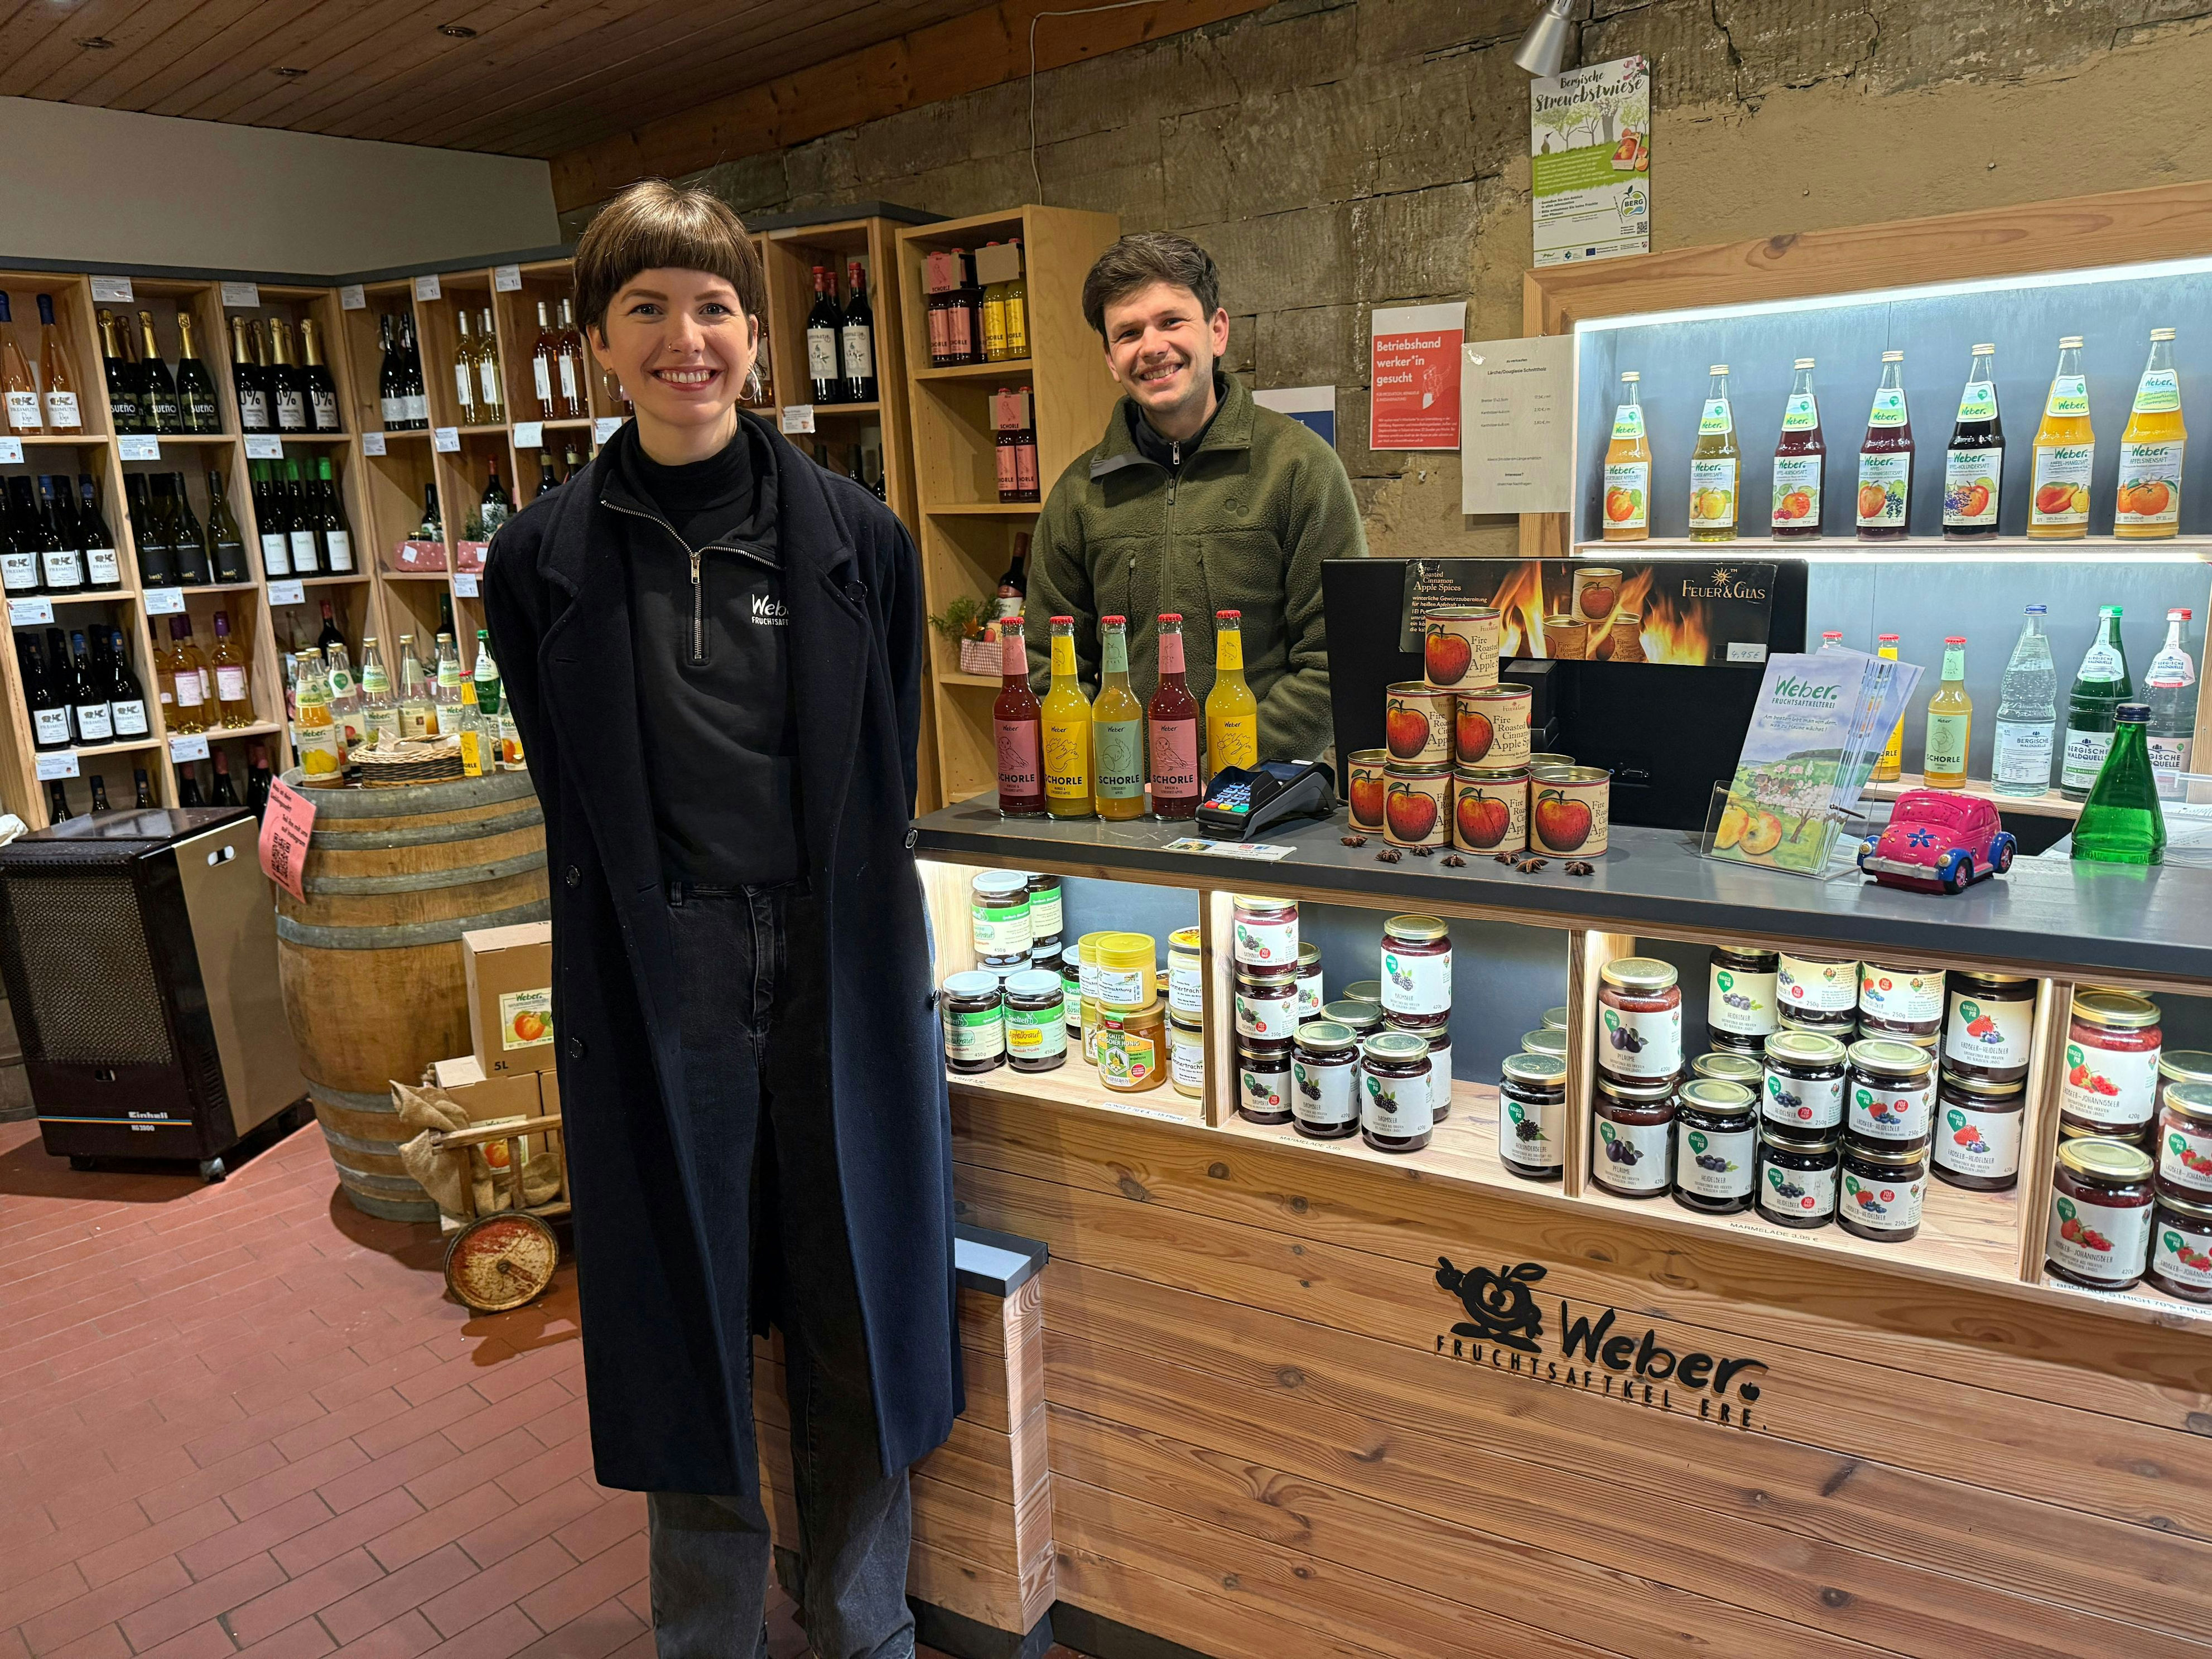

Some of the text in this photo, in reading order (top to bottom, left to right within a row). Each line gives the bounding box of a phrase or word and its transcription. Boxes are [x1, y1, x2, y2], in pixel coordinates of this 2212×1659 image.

[1560, 70, 1605, 89] Bergische
[1535, 79, 1645, 112] Streuobstwiese
[1625, 199, 1644, 207] BERG
[1377, 336, 1441, 351] Betriebshand
[1377, 372, 1413, 387] gesucht
[2055, 448, 2088, 459] Weber.
[2132, 445, 2168, 456] Weber.
[1864, 456, 1895, 466] Weber.
[1954, 452, 1987, 463] Weber.
[1695, 461, 1723, 472] Weber.
[1779, 459, 1807, 469] Weber.
[1609, 465, 1635, 475] Weber.
[1413, 581, 1461, 592] Apple Spices
[751, 594, 788, 616] Web
[1471, 636, 1487, 644] Fire
[1468, 659, 1495, 672] Apple
[1775, 675, 1842, 700] Weber.
[1772, 698, 1835, 708] FRUCHTSAFTKELTEREI
[1493, 716, 1511, 724] Fire
[1498, 721, 1526, 732] Roasted
[302, 729, 326, 737] Weber.
[1428, 734, 1453, 747] Apple
[1491, 738, 1521, 752] Apple
[1926, 754, 1960, 763] SCHORLE
[998, 773, 1035, 783] SCHORLE
[1045, 774, 1082, 785] SCHORLE
[1098, 774, 1139, 785] SCHORLE
[1153, 774, 1193, 784] SCHORLE
[1510, 799, 1524, 807] Fire
[1592, 800, 1605, 809] Fire
[515, 992, 542, 1001] Weber.
[1009, 1015, 1029, 1025] Spelten
[1728, 1012, 1751, 1021] HEIDELBEER
[1618, 1053, 1635, 1062] PFLAUME
[1775, 1107, 1796, 1118] HEIDELBEER
[1280, 1136, 1326, 1147] MARMELADE
[1515, 1142, 1546, 1152] HOLUNDERBEERE
[1613, 1165, 1630, 1174] PFLAUME
[1702, 1175, 1726, 1184] HEIDELBEER
[1776, 1199, 1800, 1208] HEIDELBEER
[1730, 1223, 1789, 1237] MARMELADE
[2056, 1282, 2212, 1316] BROTAUFSTRICH 70% FRUC
